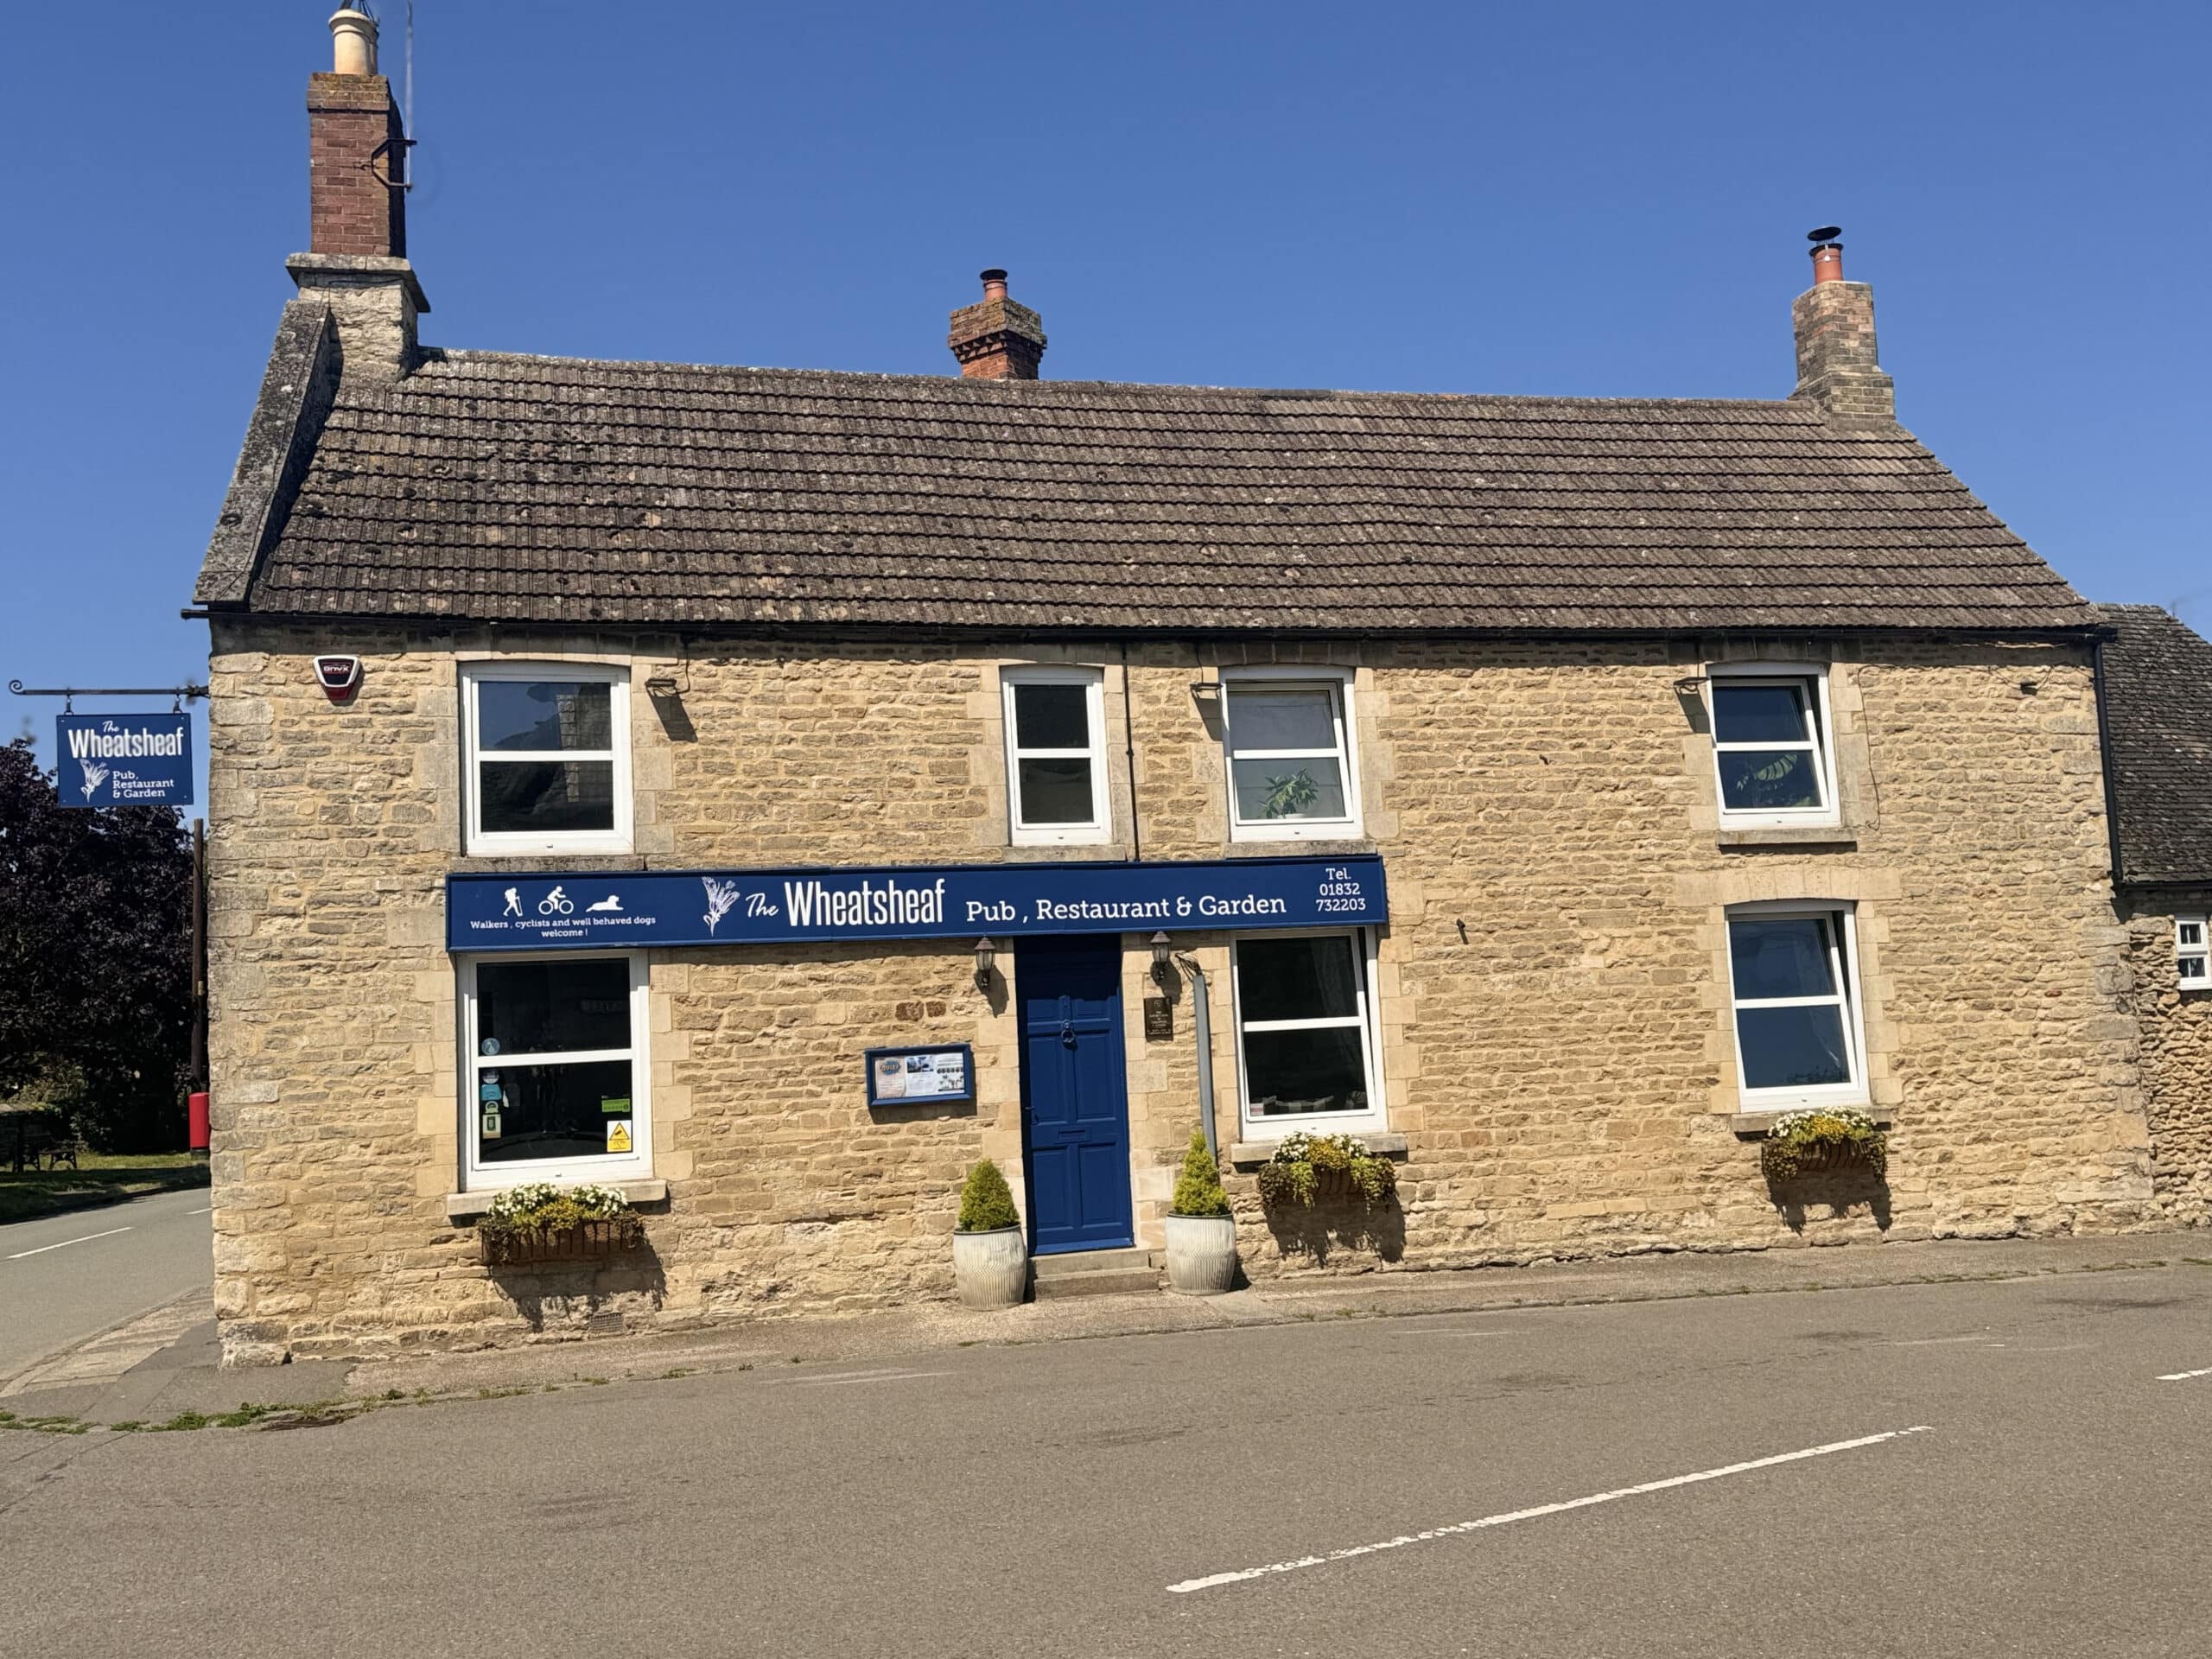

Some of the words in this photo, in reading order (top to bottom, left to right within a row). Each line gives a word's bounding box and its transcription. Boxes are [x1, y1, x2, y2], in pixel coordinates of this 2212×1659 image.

[102, 720, 120, 734] The
[67, 726, 184, 760] Wheatsheaf
[112, 779, 175, 790] Restaurant
[112, 789, 121, 798] &
[124, 788, 166, 798] Garden
[1325, 867, 1351, 880] Tel.
[1319, 882, 1361, 896] 01832
[745, 893, 779, 918] The
[784, 878, 945, 927] Wheatsheaf
[1036, 898, 1171, 920] Restaurant
[1176, 896, 1192, 917] &
[1198, 893, 1287, 916] Garden
[1315, 898, 1366, 912] 732203
[515, 918, 550, 930] cyclists
[552, 918, 570, 927] and
[572, 917, 591, 926] well
[593, 917, 632, 925] behaved
[633, 916, 656, 926] dogs
